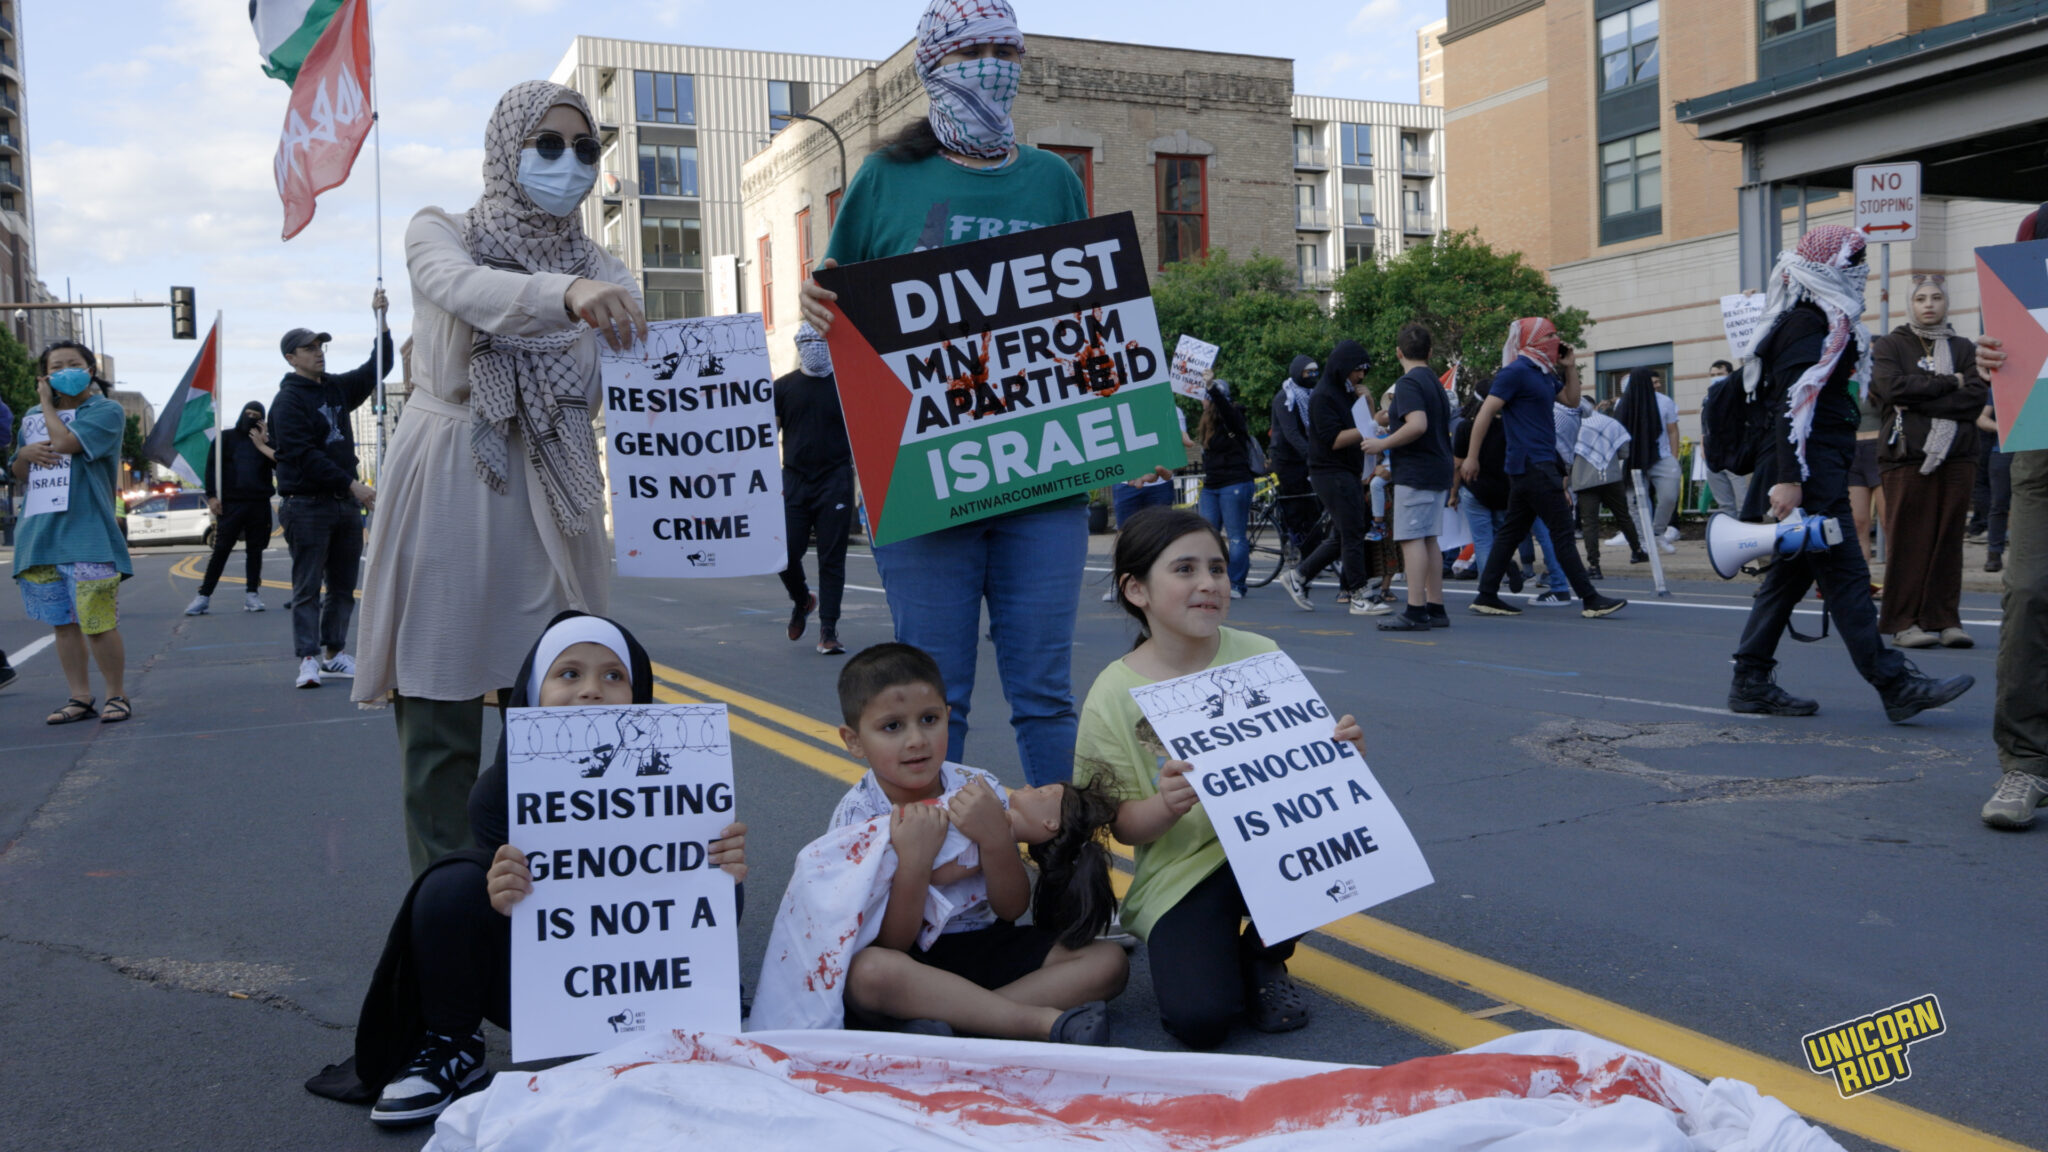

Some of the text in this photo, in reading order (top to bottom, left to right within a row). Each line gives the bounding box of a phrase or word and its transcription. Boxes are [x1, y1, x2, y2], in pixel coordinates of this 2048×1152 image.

[1871, 172, 1902, 192] NO
[1859, 196, 1914, 214] STOPPING
[950, 215, 1046, 241] FRE
[891, 238, 1121, 334] DIVEST
[905, 309, 1125, 390] MN FROM
[607, 378, 773, 413] RESISTING
[916, 346, 1157, 434] APARTHEID
[614, 423, 774, 457] GENOCIDE
[926, 402, 1159, 501] ISRAEL
[32, 476, 69, 490] ISRAEL
[628, 469, 768, 499] IS NOT A
[949, 463, 1125, 519] ANTIWARCOMMITTEE.ORG
[652, 514, 751, 541] CRIME
[1169, 698, 1329, 761] RESISTING
[1202, 737, 1354, 797] GENOCIDE
[516, 782, 733, 825] RESISTING
[1233, 779, 1373, 842] IS NOT A
[1278, 826, 1379, 882] CRIME
[537, 896, 717, 942] IS NOT A
[563, 956, 693, 998] CRIME
